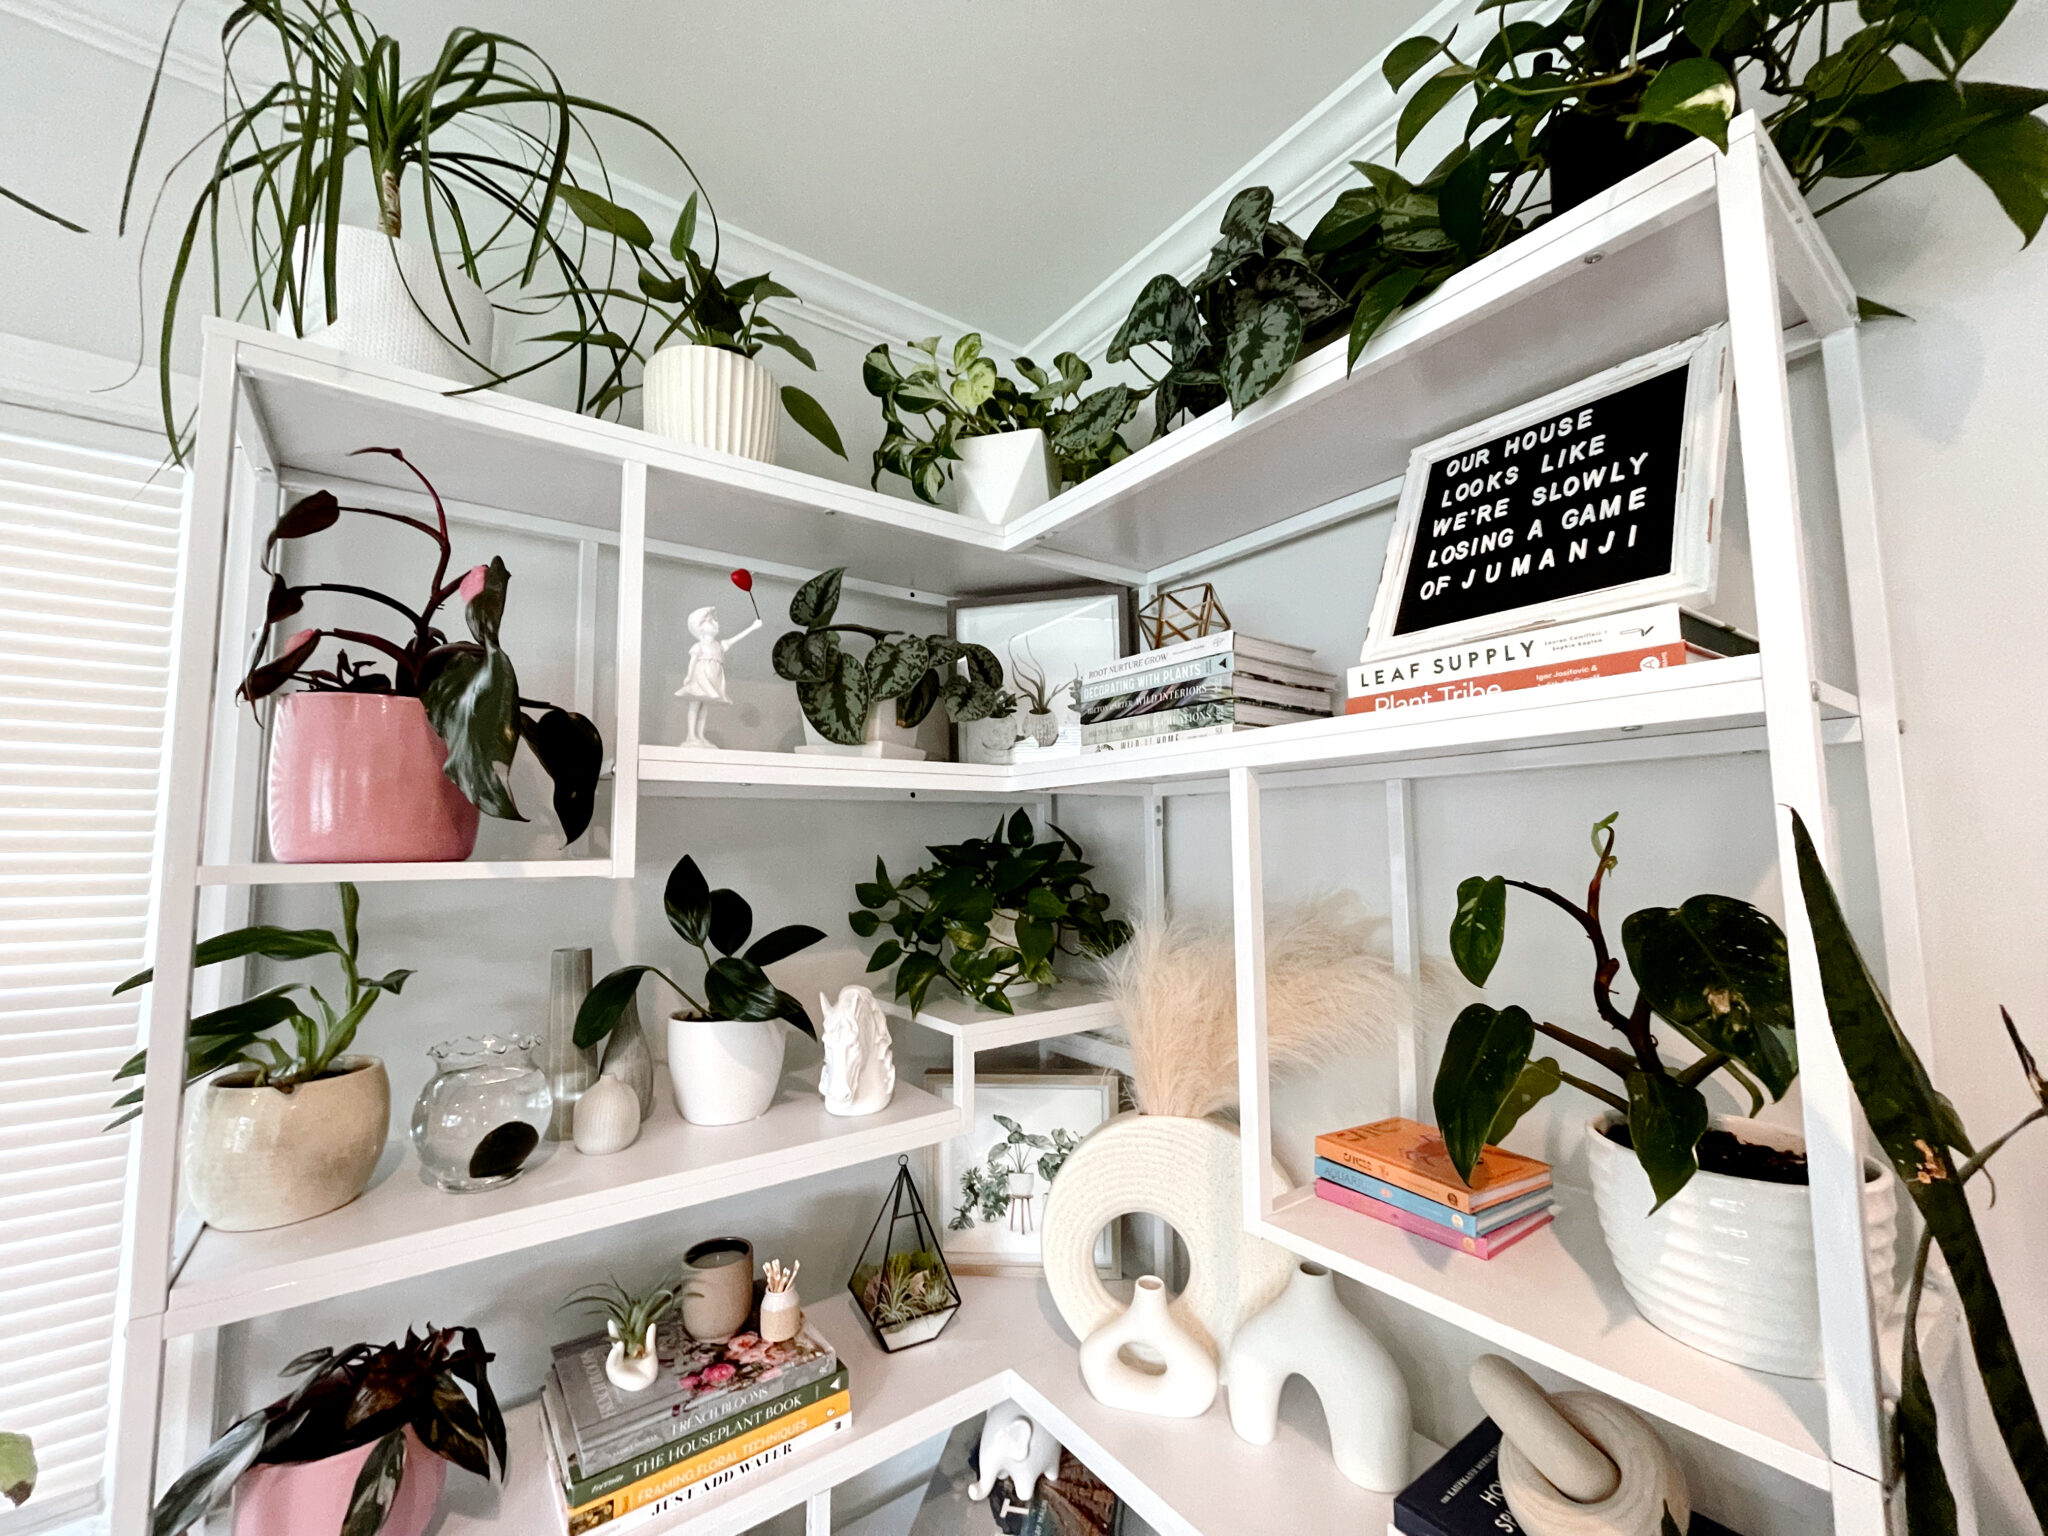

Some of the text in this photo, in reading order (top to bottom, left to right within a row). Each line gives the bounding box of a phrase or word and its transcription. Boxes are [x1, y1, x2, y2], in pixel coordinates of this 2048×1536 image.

[1441, 434, 1606, 508] LOOKS LIKE
[1446, 408, 1593, 478] OUR HOUSE
[1427, 487, 1647, 569] LOSING A GAME
[1432, 452, 1649, 538] WE'RE SLOWLY
[1419, 524, 1638, 601] OF JUMANJI
[1084, 678, 1134, 699] DECORATING
[1138, 673, 1160, 688] WITH
[1163, 663, 1201, 683] PLANTS
[1088, 653, 1168, 679] ROOT NURTURE GROW
[1159, 685, 1207, 701] INTERIORS
[1361, 640, 1534, 688] LEAF SUPPLY
[1536, 672, 1553, 681] Igor
[632, 1452, 664, 1477] THE
[668, 1411, 764, 1463] HOUSEPLANT
[765, 1394, 802, 1418] BOOK
[671, 1386, 769, 1436] FRENCH BLOOMS
[638, 1418, 808, 1503] FRAMING FLORAL TECHNIQUES
[651, 1442, 793, 1516] JUST ADD WATER
